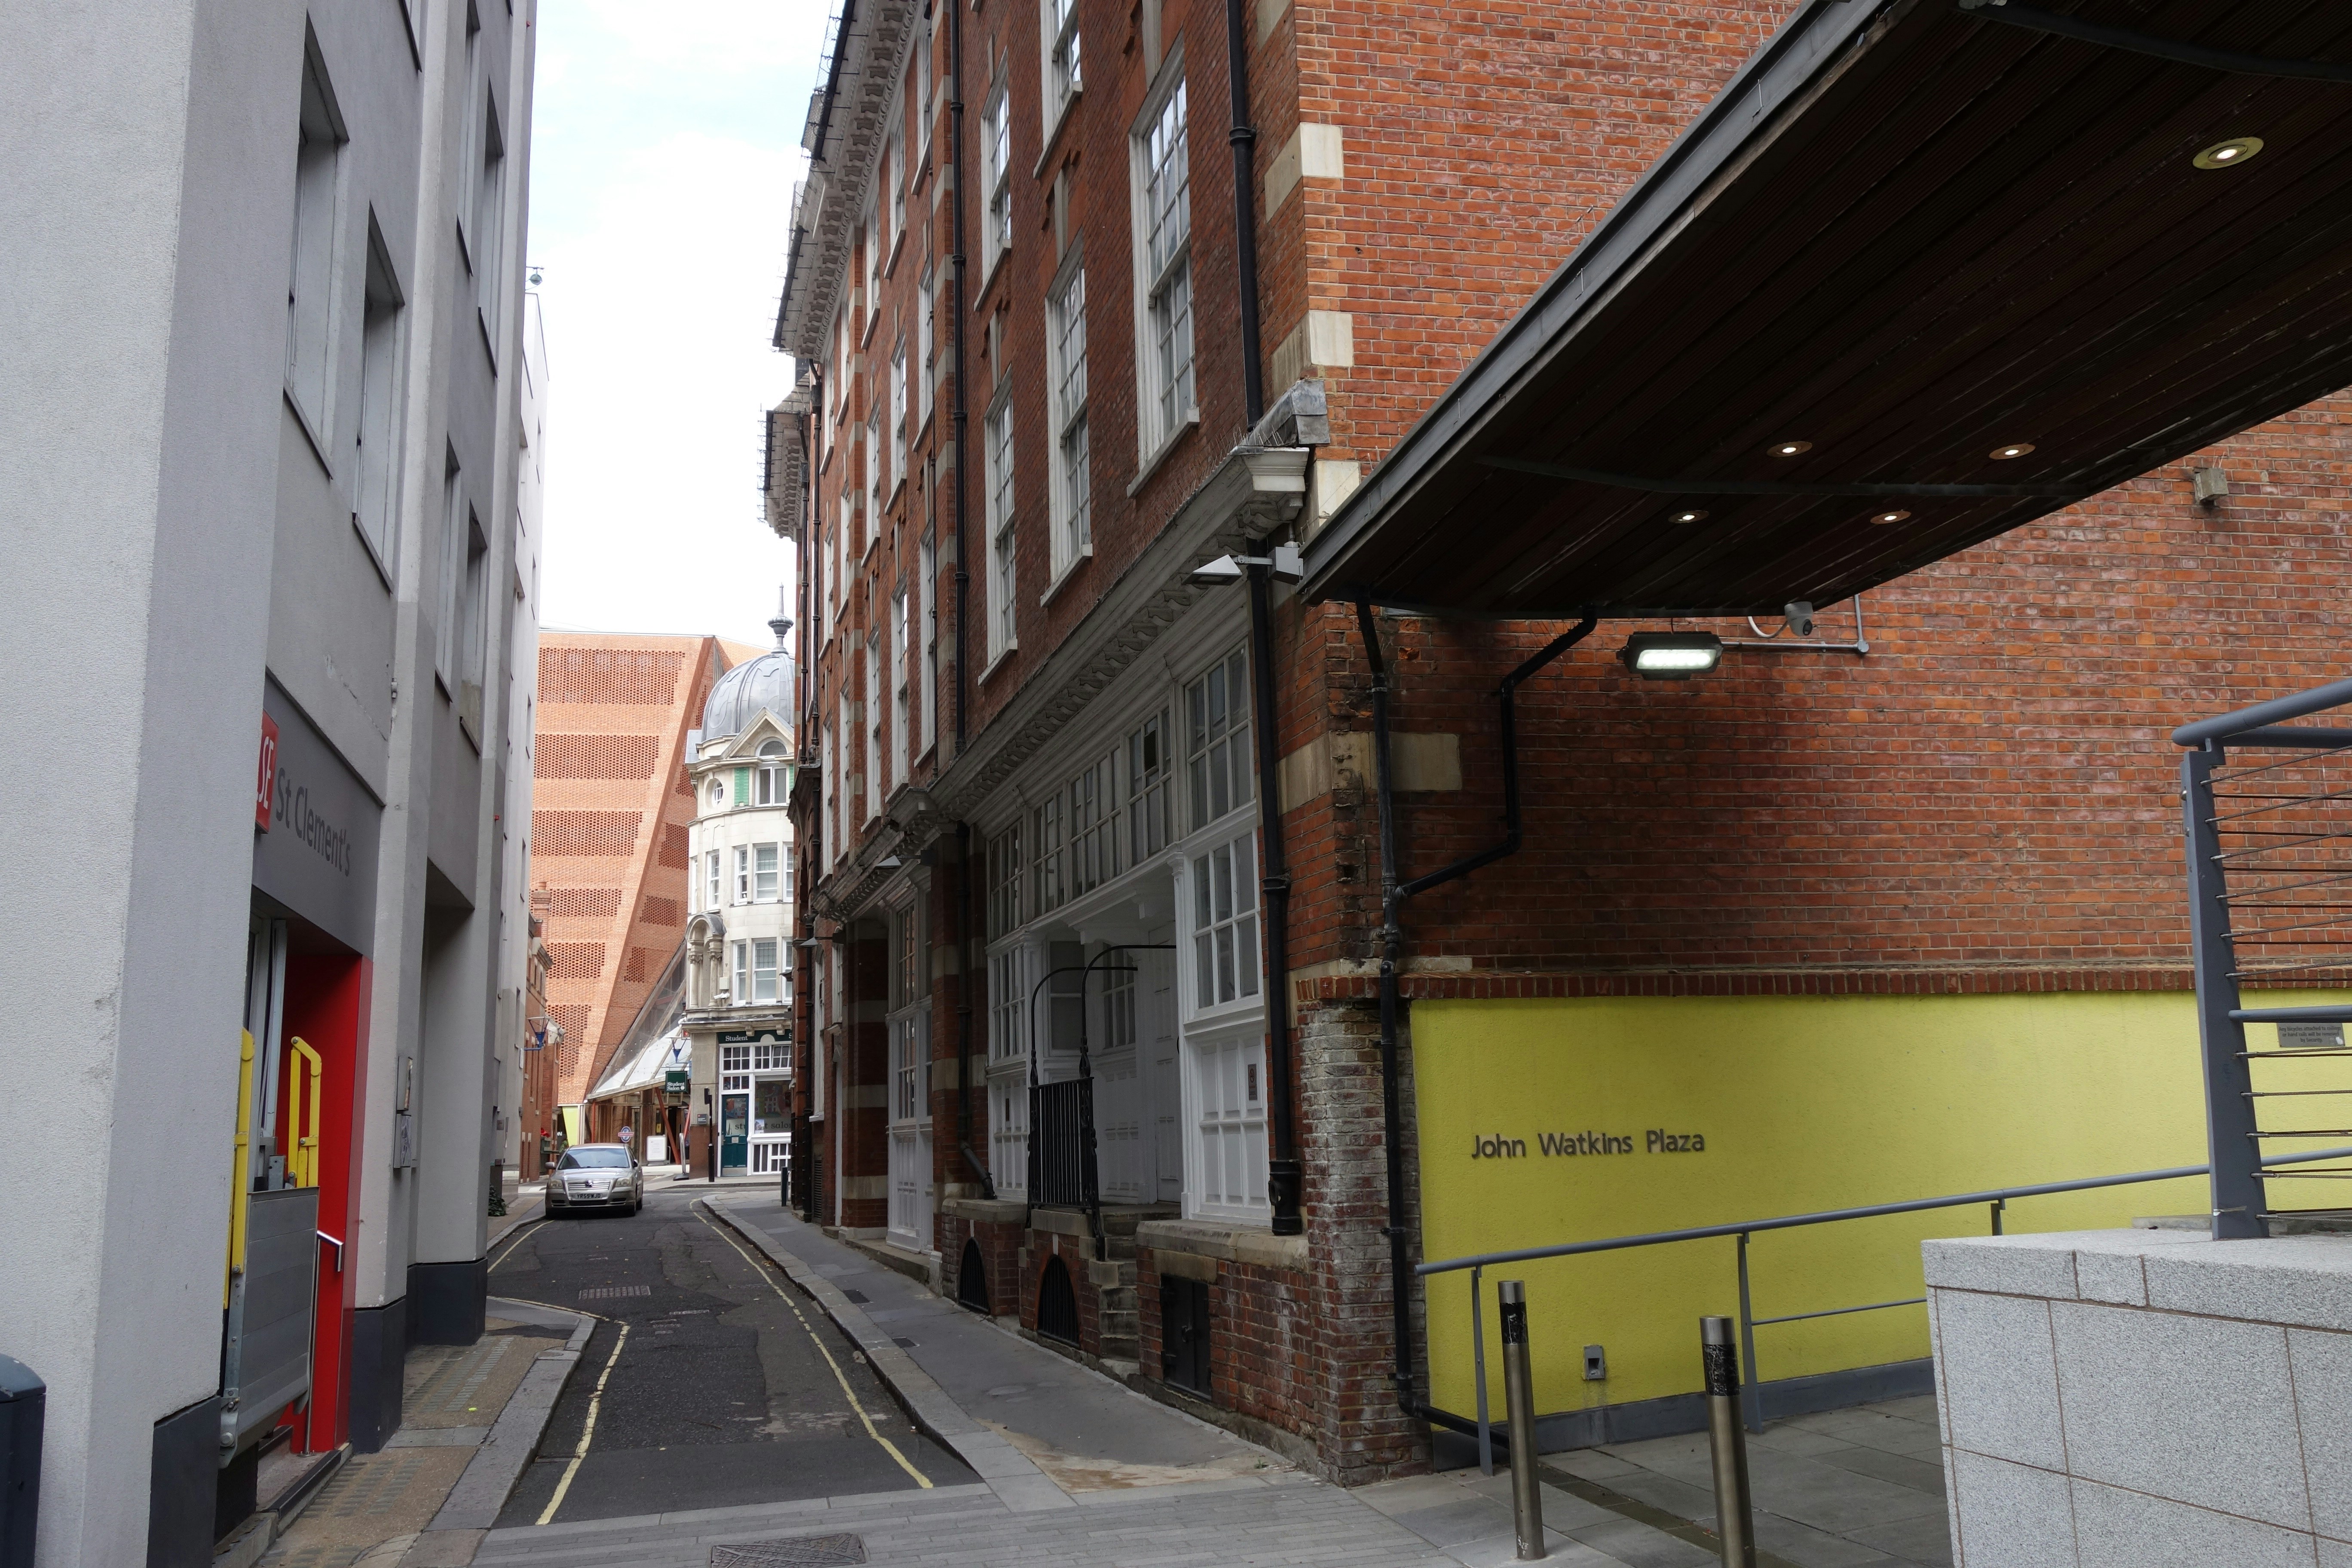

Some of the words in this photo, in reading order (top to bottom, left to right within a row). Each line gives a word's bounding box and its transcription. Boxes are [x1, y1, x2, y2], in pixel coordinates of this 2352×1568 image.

[276, 767, 291, 829] St
[295, 786, 350, 877] Clement's
[1472, 1133, 1526, 1158] John
[1537, 1130, 1633, 1157] Watkins
[1646, 1128, 1705, 1153] Plaza
